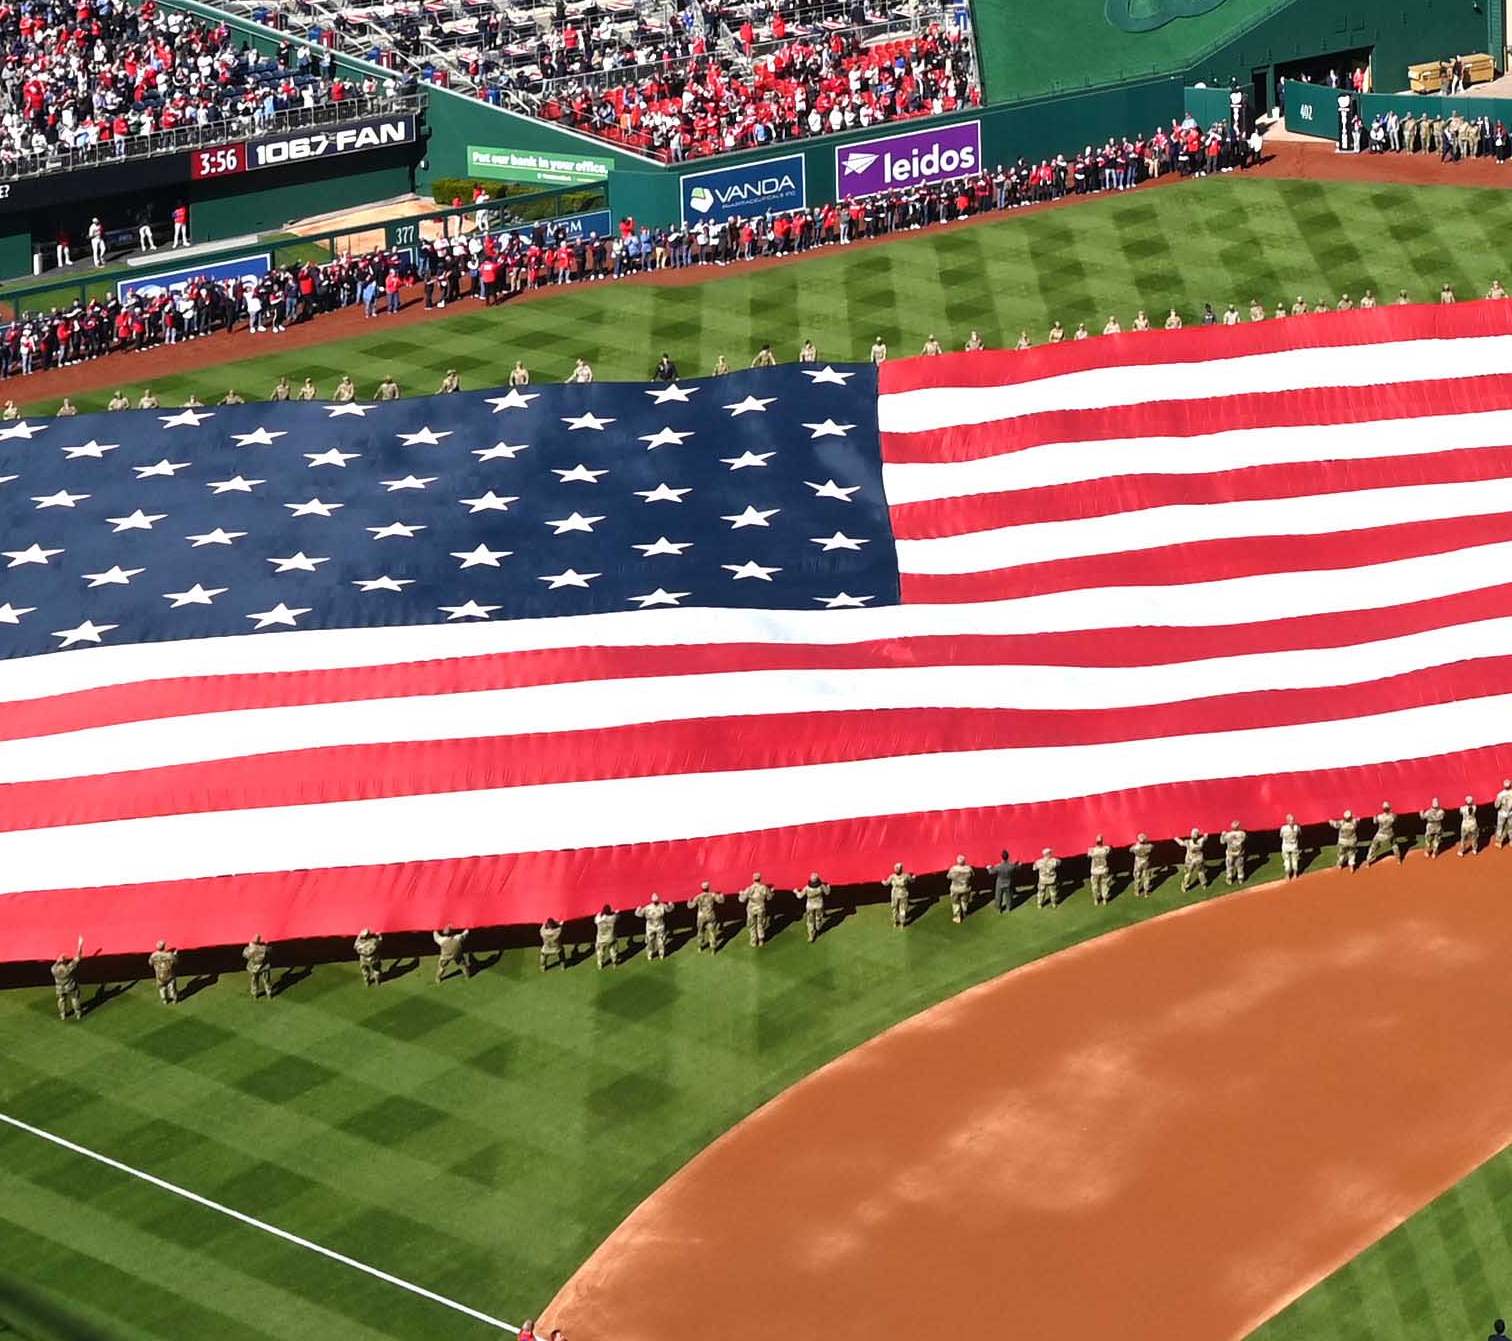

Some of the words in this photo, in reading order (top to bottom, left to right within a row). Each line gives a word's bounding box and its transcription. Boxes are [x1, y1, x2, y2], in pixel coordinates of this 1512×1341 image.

[199, 147, 239, 176] 3:56
[255, 134, 331, 166] 106.7
[336, 121, 406, 151] FAN
[883, 142, 976, 184] leidos
[714, 174, 797, 204] VANDA
[395, 225, 415, 246] 377
